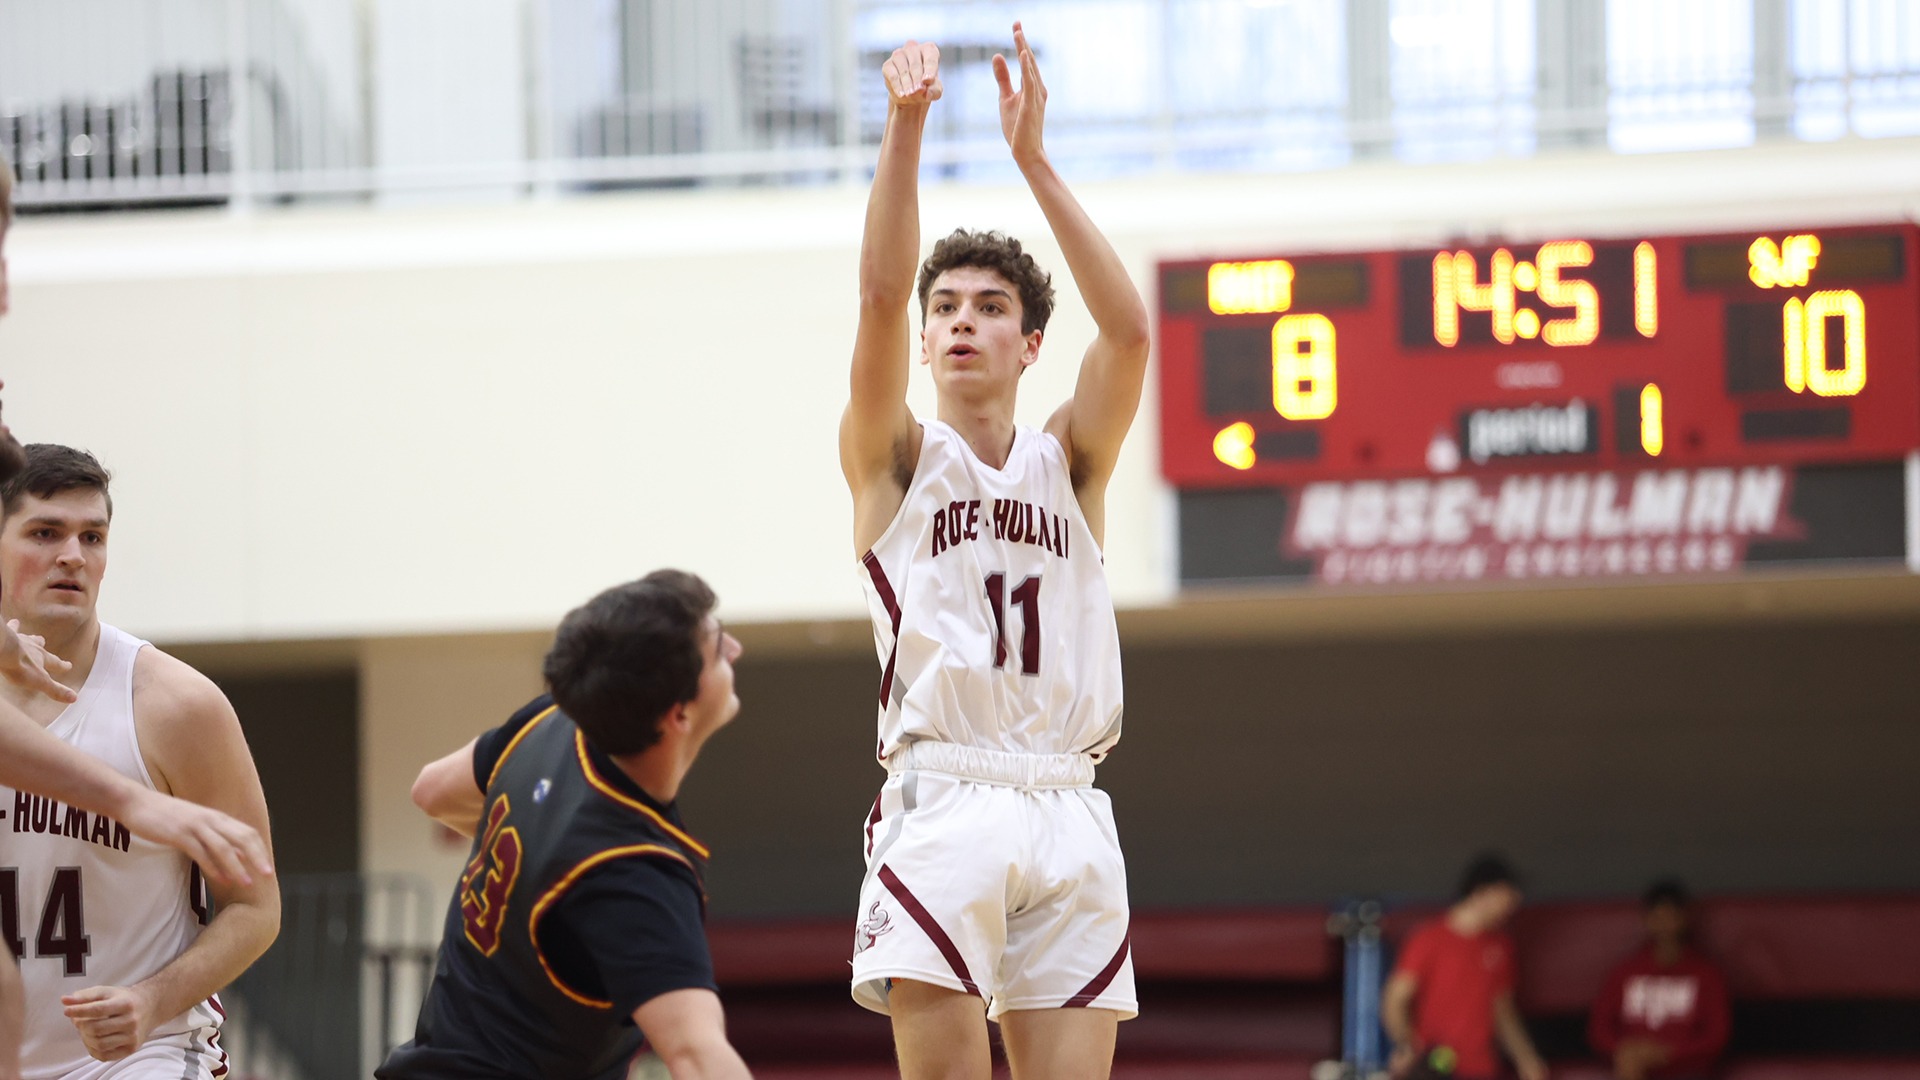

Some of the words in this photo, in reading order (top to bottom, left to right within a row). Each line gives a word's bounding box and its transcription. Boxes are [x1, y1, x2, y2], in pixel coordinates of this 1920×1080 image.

[1432, 240, 1659, 347] 14:51
[1783, 289, 1867, 397] 10
[1271, 313, 1338, 420] 8
[1640, 383, 1663, 456] 1
[983, 571, 1043, 677] 11
